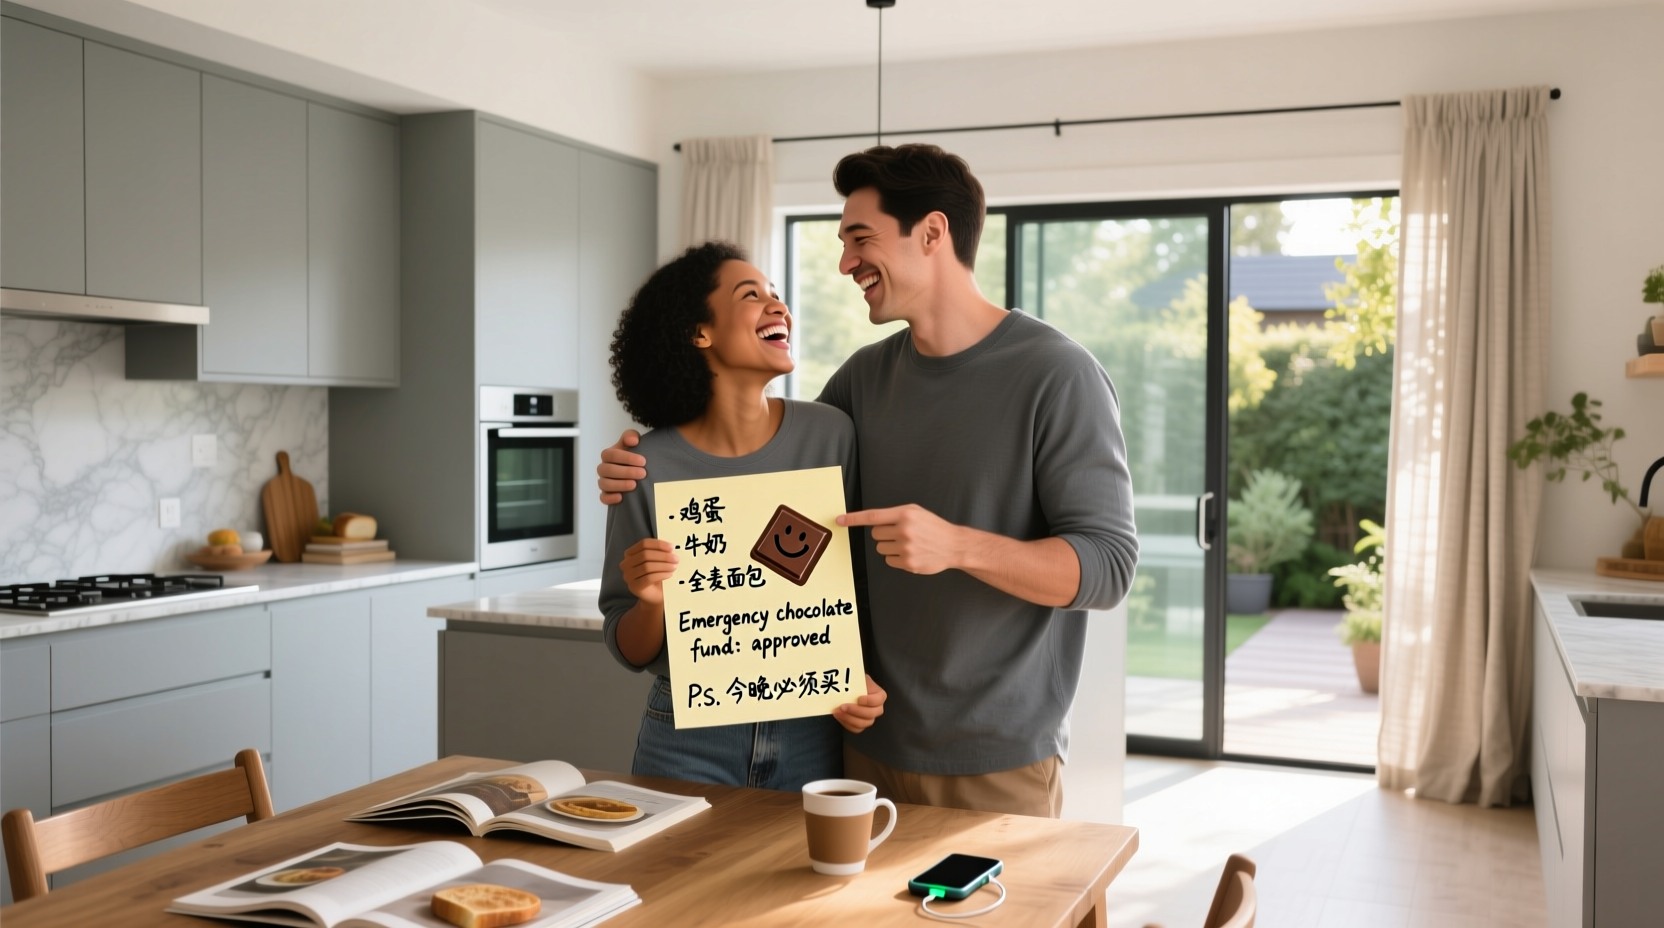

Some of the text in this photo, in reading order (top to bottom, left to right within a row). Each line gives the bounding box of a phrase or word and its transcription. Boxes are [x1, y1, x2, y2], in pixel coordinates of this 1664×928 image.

[679, 496, 726, 525] 鸡蛋
[684, 532, 727, 558] 牛奶
[688, 564, 767, 593] 全麦面包
[679, 597, 854, 636] Emergency chocolate
[690, 624, 831, 663] fund: approved
